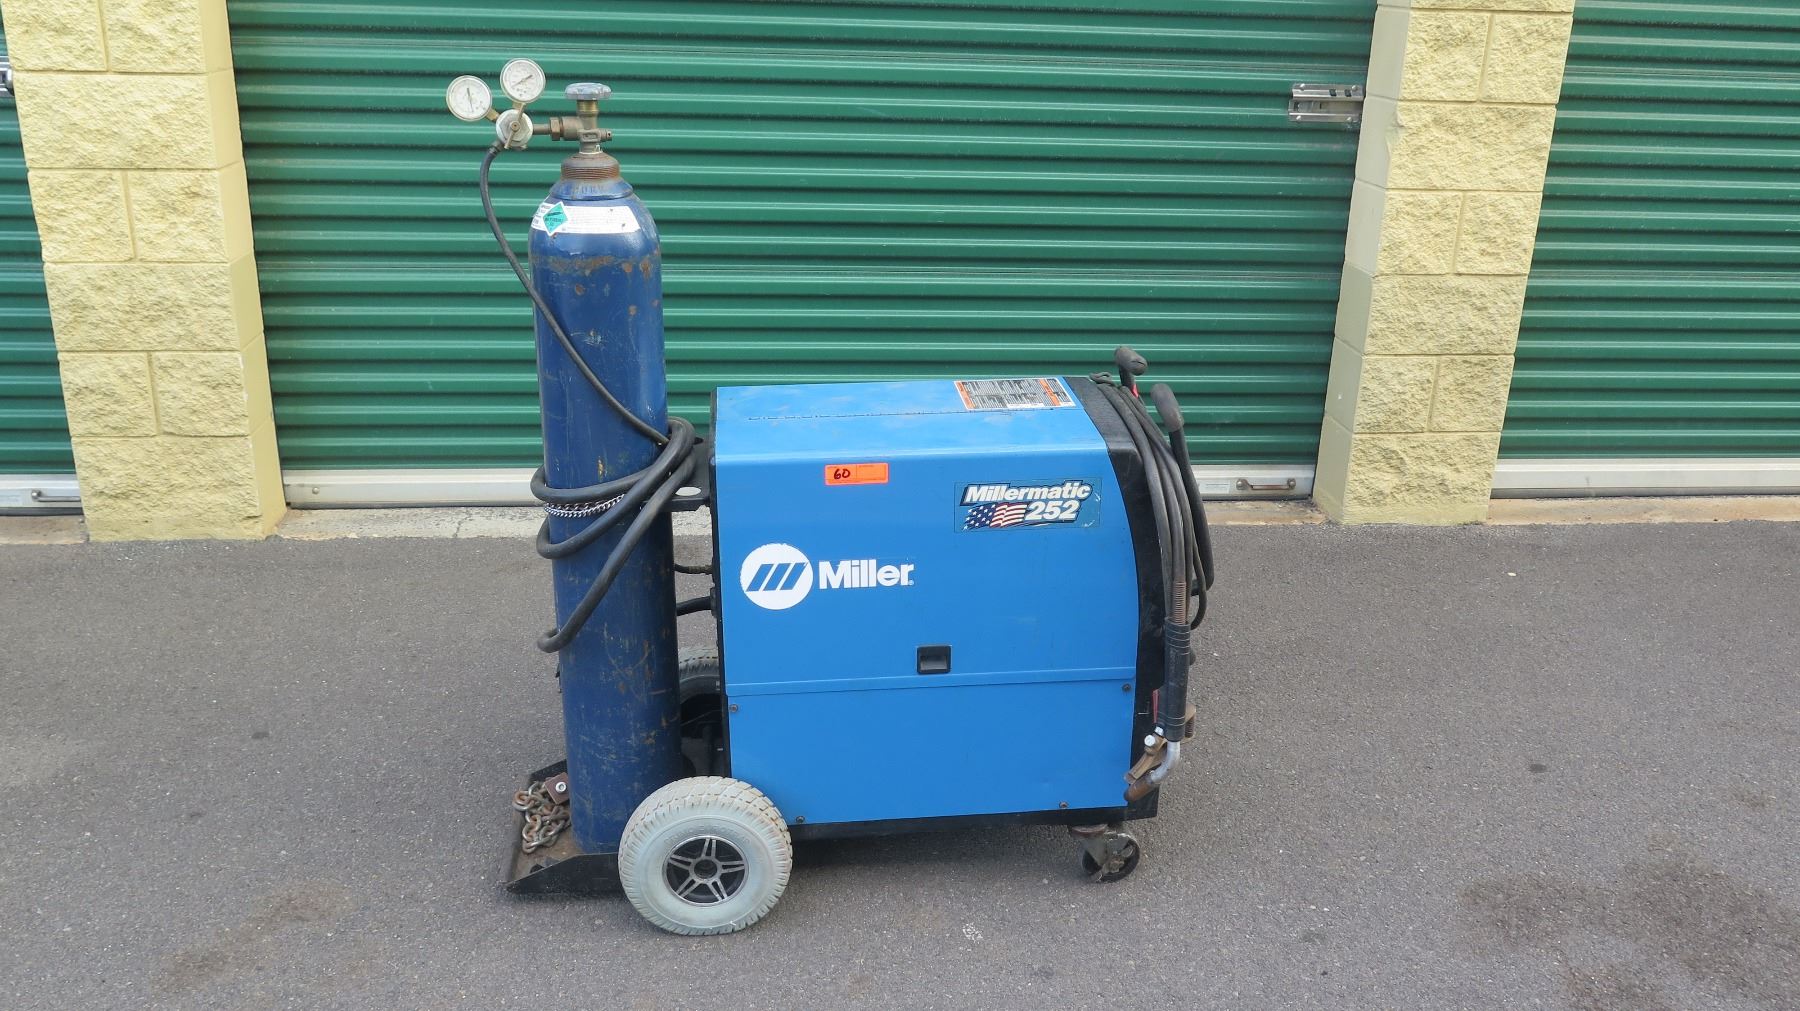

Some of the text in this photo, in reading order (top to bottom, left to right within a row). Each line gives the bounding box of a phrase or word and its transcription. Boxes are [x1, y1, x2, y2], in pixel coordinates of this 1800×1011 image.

[833, 468, 851, 480] 60
[965, 482, 1091, 503] Millermatic
[1024, 500, 1080, 520] 252
[818, 559, 914, 590] Miller
